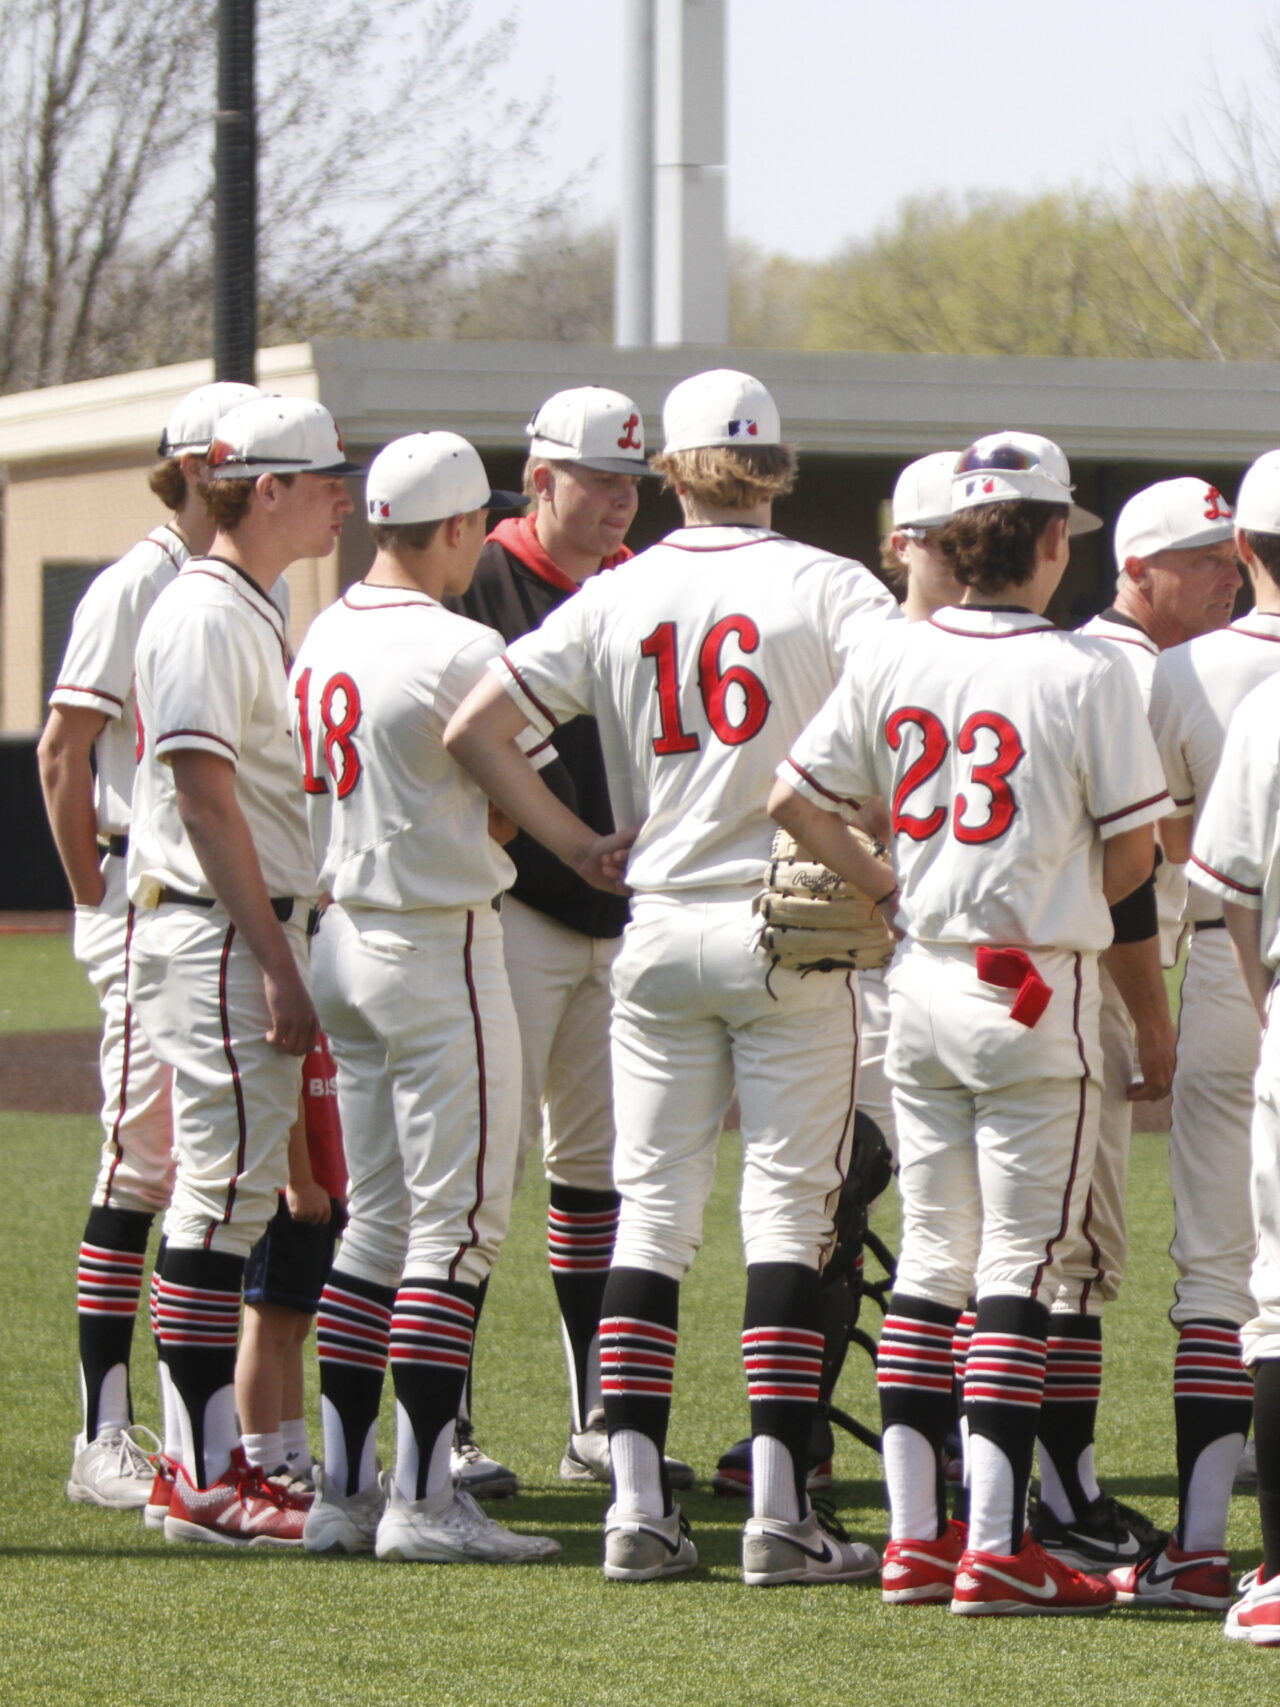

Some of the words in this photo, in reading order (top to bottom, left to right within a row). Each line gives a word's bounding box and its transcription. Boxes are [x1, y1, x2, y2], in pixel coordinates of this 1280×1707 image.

[617, 412, 643, 450] L
[294, 667, 364, 800] 18
[640, 612, 772, 757] 16
[883, 705, 1026, 846] 23
[792, 869, 848, 893] Rawling
